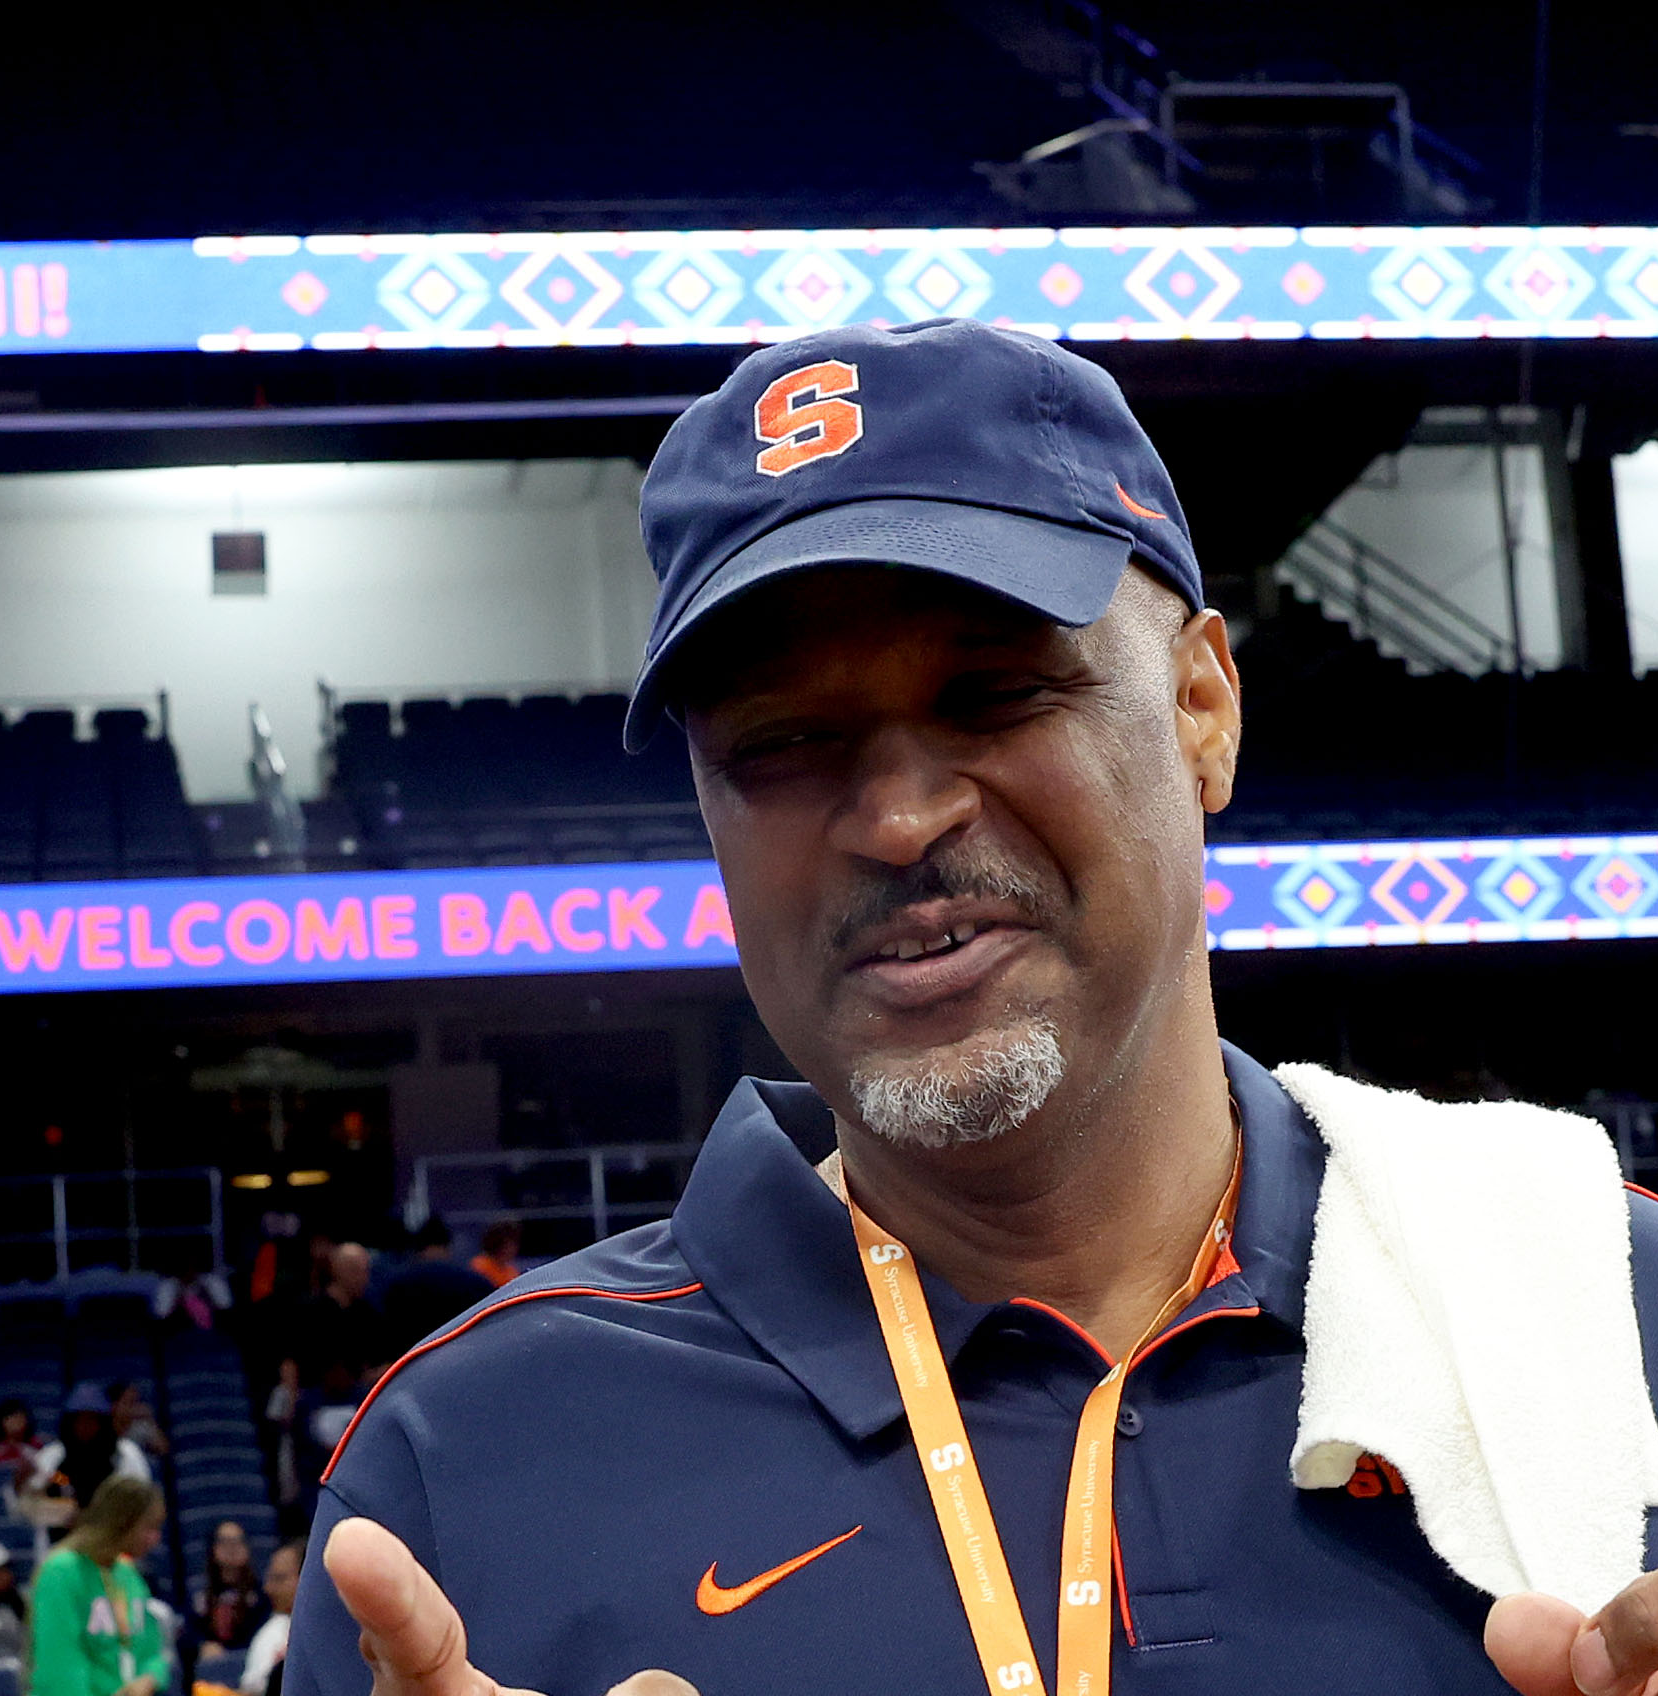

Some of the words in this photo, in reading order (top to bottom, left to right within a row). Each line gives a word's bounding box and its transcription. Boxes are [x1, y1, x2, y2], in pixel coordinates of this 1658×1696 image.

[754, 359, 864, 477] S
[439, 887, 666, 957] BACK
[869, 1243, 905, 1265] S
[883, 1266, 909, 1323] Syracuse
[902, 1321, 929, 1388] University
[930, 1442, 966, 1472] S
[1079, 1439, 1100, 1508] University
[946, 1474, 975, 1536] Syracuse
[967, 1536, 997, 1603] University
[1077, 1508, 1094, 1573] Syracuse
[1066, 1580, 1101, 1606] S
[997, 1660, 1034, 1690] S
